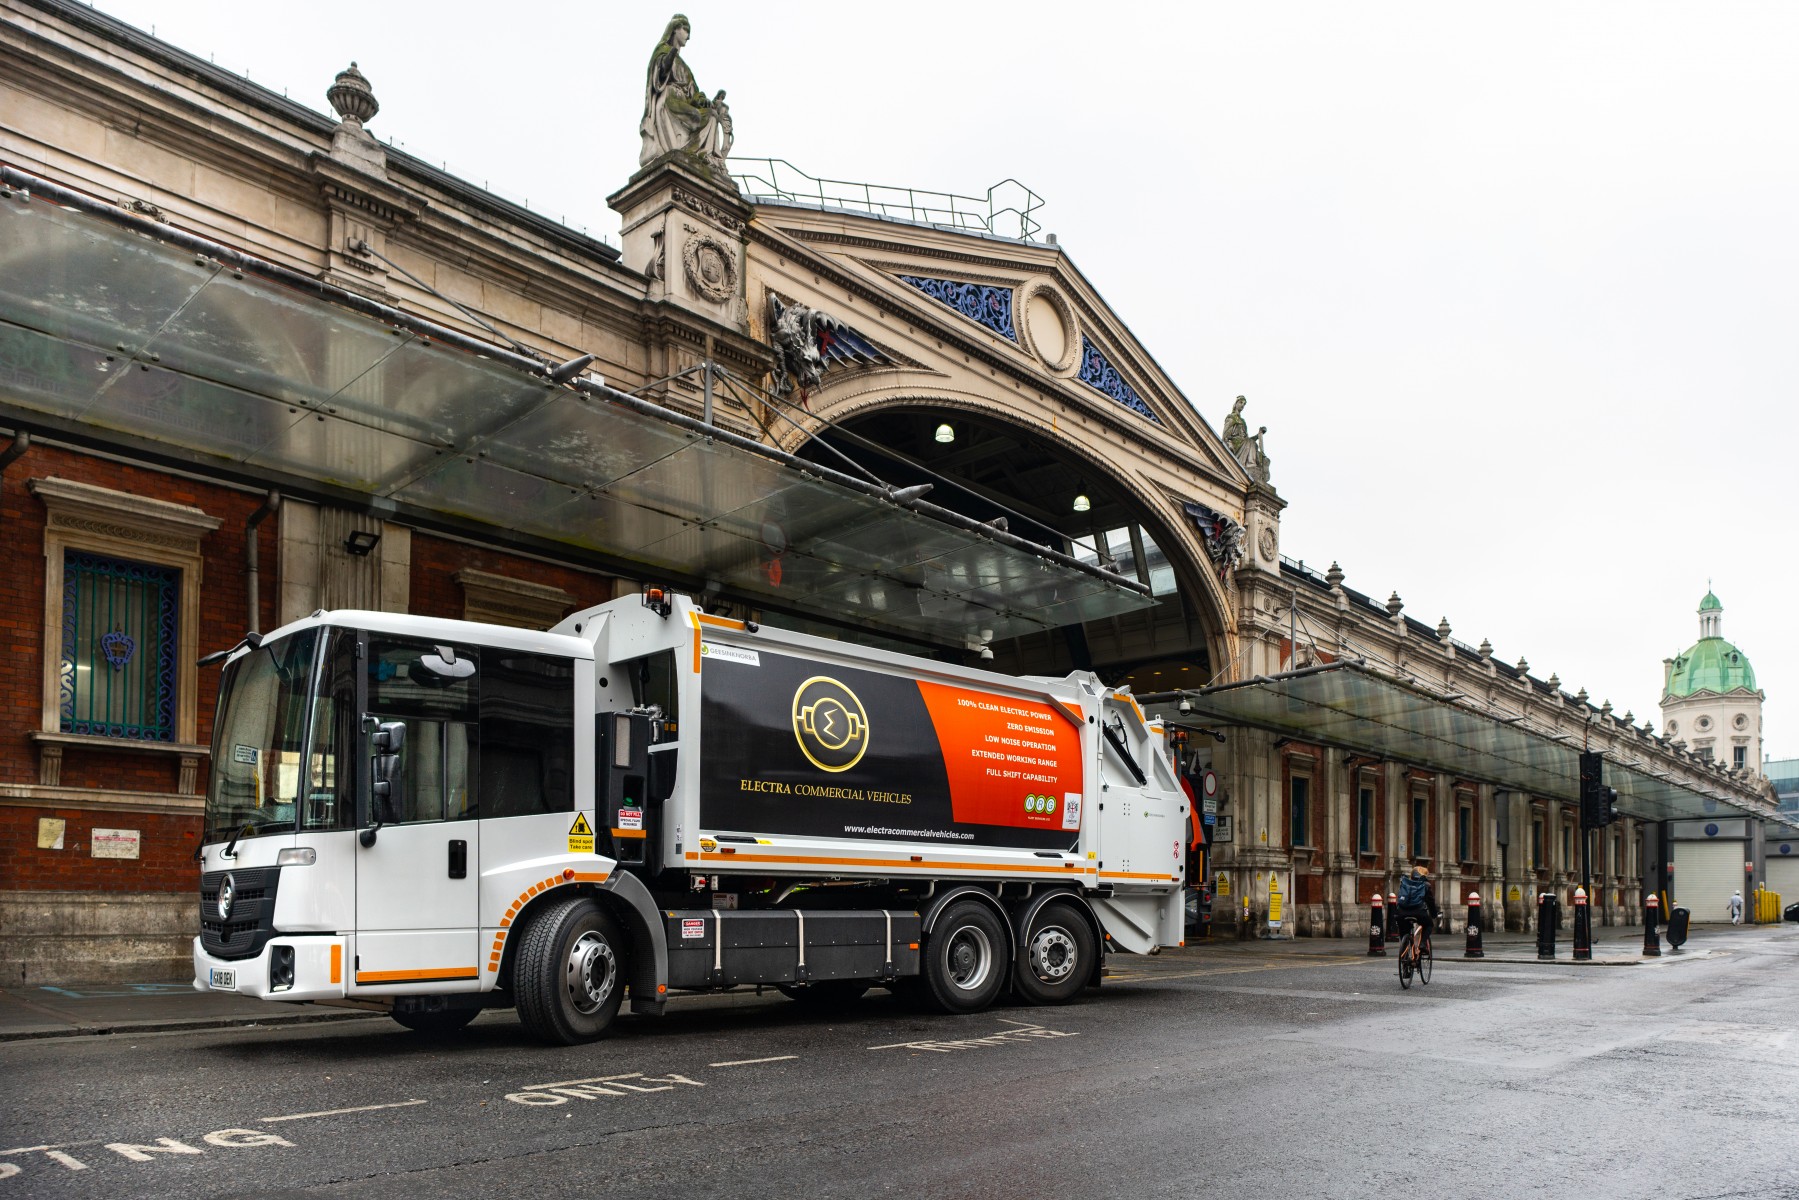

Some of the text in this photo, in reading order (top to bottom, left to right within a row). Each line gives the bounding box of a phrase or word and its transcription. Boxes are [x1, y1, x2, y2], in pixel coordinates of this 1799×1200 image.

[957, 698, 1052, 721] 100% CLEAN ELECTRIC POWER
[1007, 722, 1054, 736] ZERO EMISSION
[985, 735, 1056, 751] LOW NOISE OPERATION
[971, 749, 1057, 768] EXTENDED WORKING RANGE
[986, 768, 1058, 783] FULL SHIFT CAPABILITY
[740, 779, 912, 805] ELECTRA COMMERCIAL VEHICLES
[1026, 797, 1055, 812] NRG
[844, 825, 975, 840] www.electracommercialvehicles.com
[504, 1073, 705, 1106] ONLY
